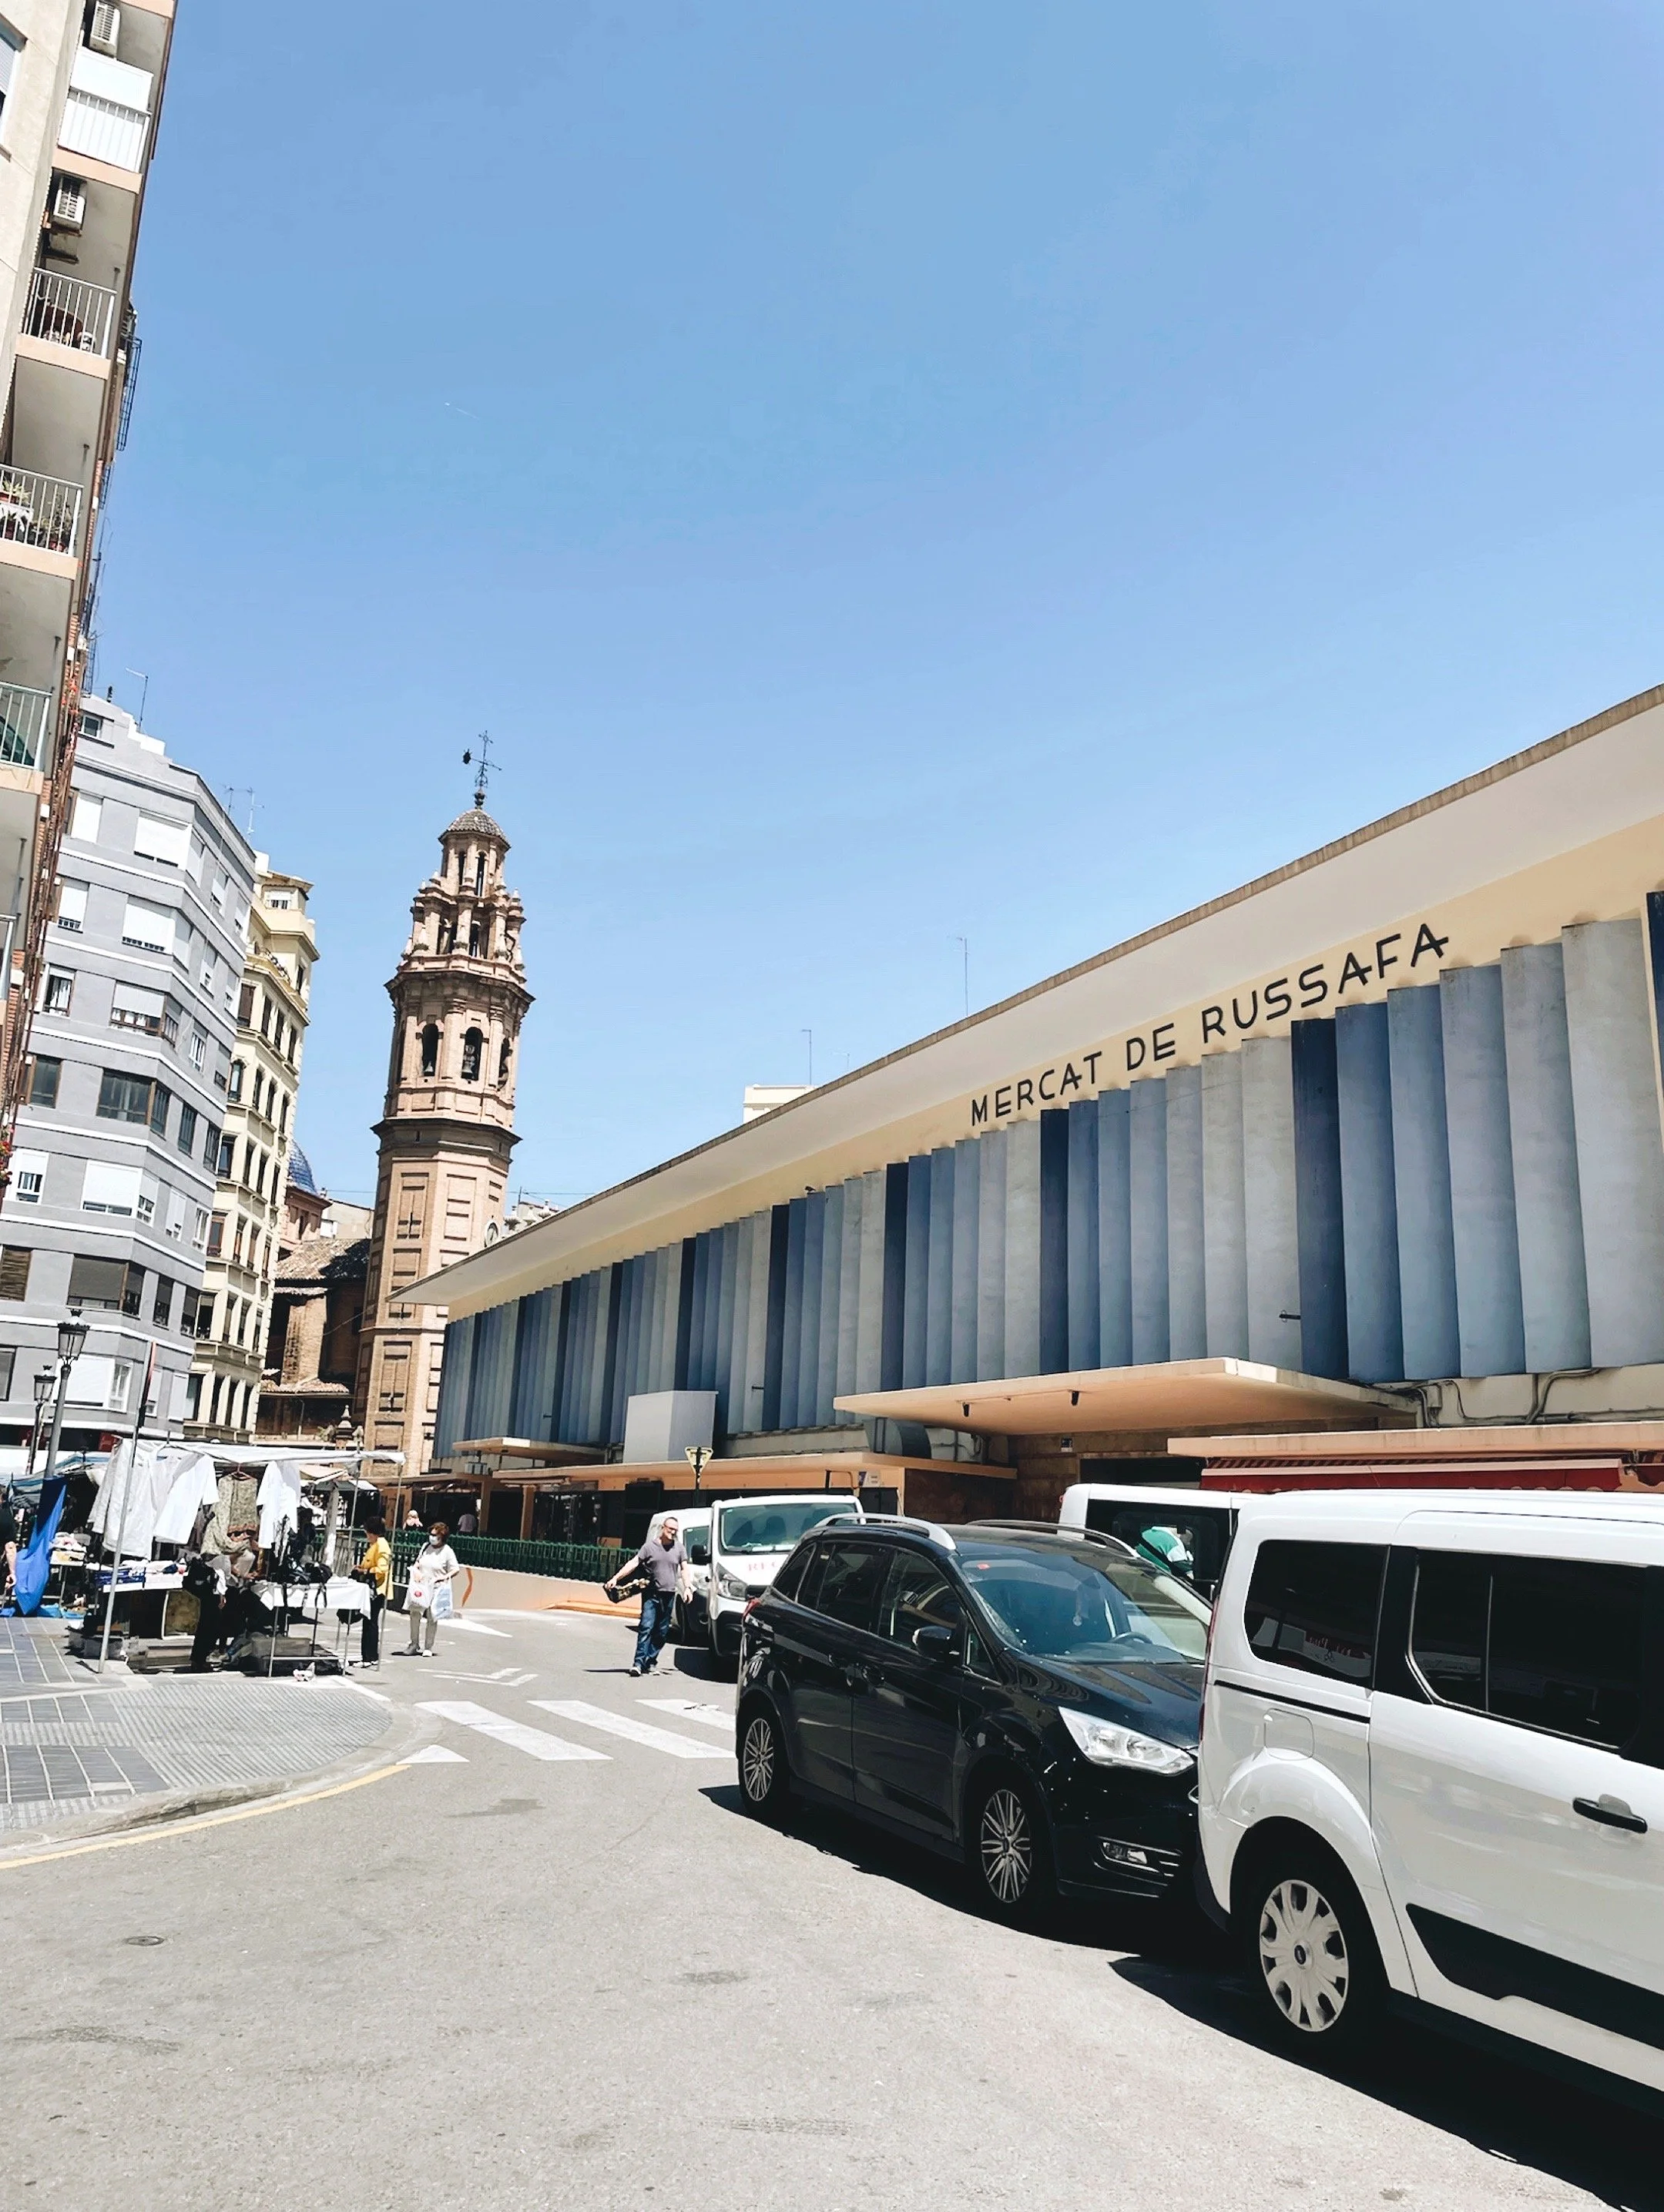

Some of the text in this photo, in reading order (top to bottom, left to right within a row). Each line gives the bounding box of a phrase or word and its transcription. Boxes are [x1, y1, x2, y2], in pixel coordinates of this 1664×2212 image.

[971, 923, 1450, 1127] MERCAT DE RUSSAFA
